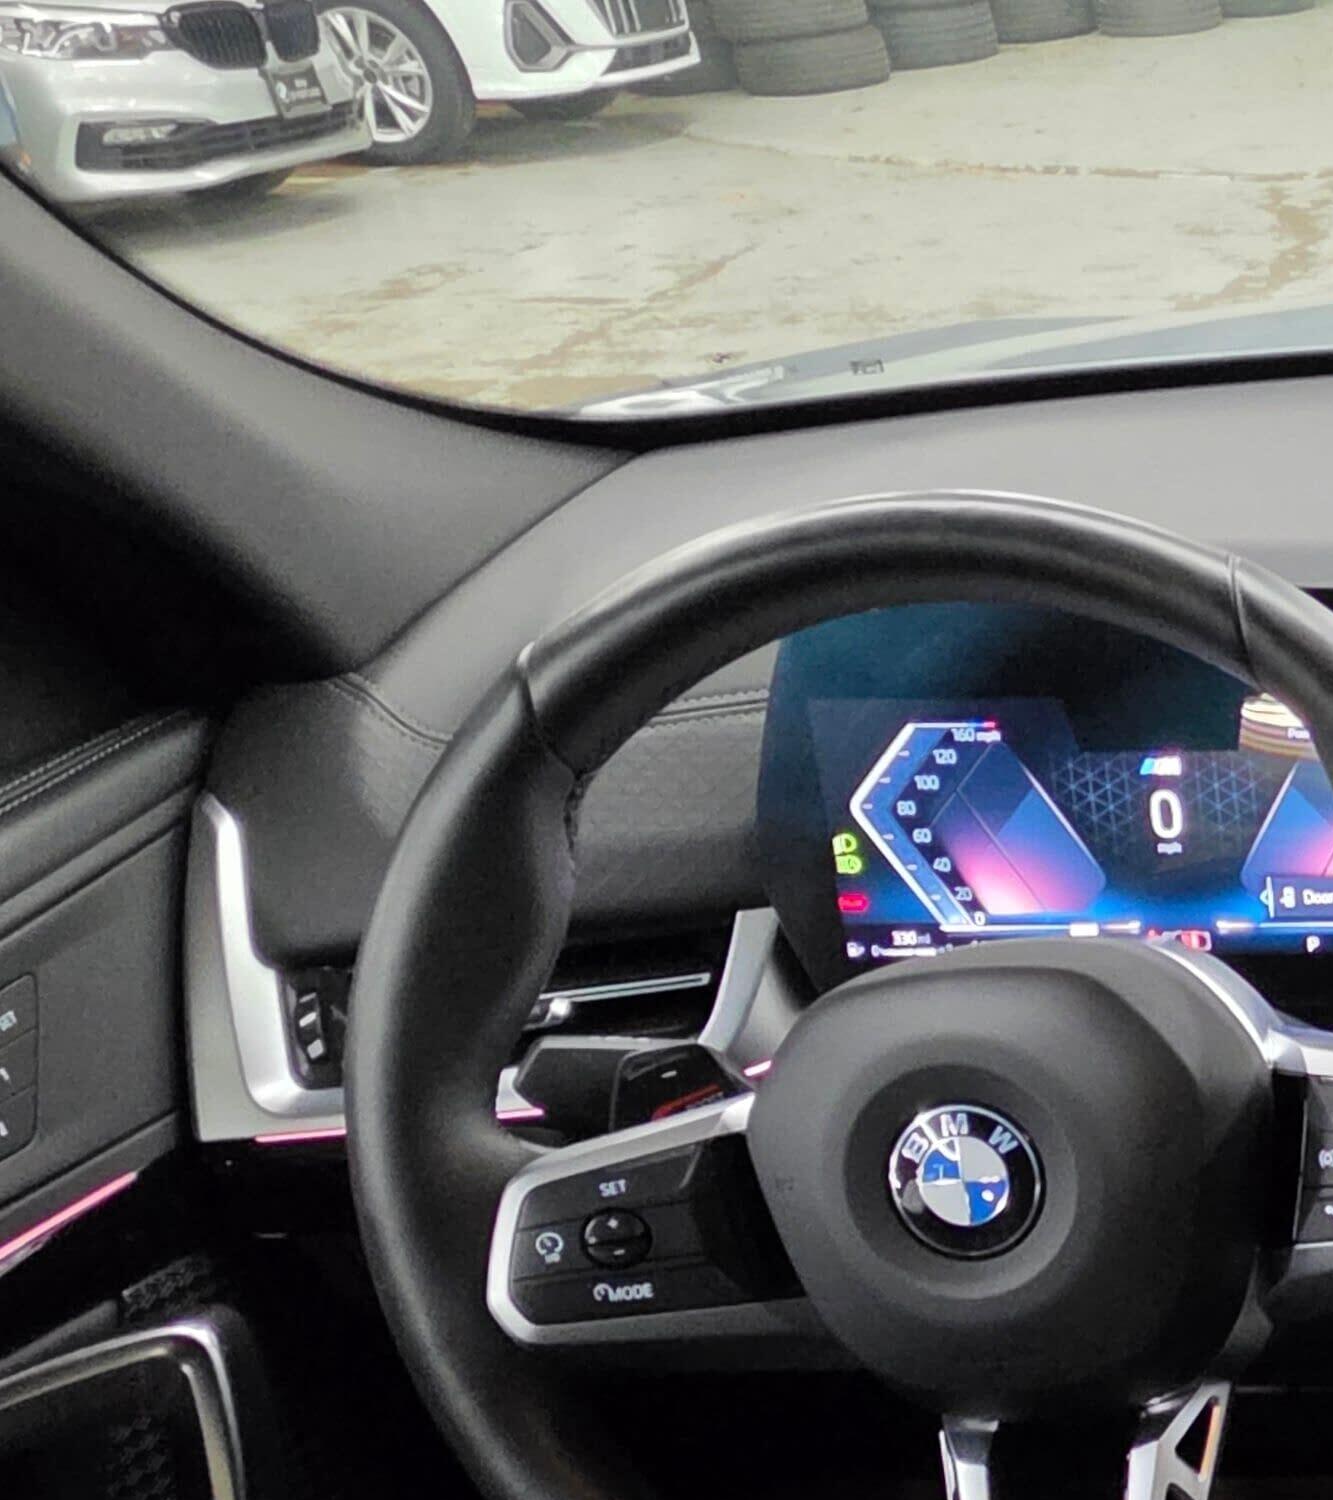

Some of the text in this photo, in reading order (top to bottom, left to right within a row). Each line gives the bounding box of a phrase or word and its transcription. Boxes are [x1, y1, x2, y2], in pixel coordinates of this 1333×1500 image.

[951, 727, 976, 743] 160
[932, 748, 958, 765] 120
[914, 775, 940, 791] 100
[896, 800, 917, 817] 80
[1150, 789, 1184, 839] 0
[911, 827, 933, 844] 60
[954, 886, 973, 902] 20
[973, 911, 986, 926] 0
[1306, 936, 1320, 952] P
[901, 1113, 1019, 1163] BMW
[598, 1178, 627, 1198] SET
[608, 1282, 655, 1303] MODE
